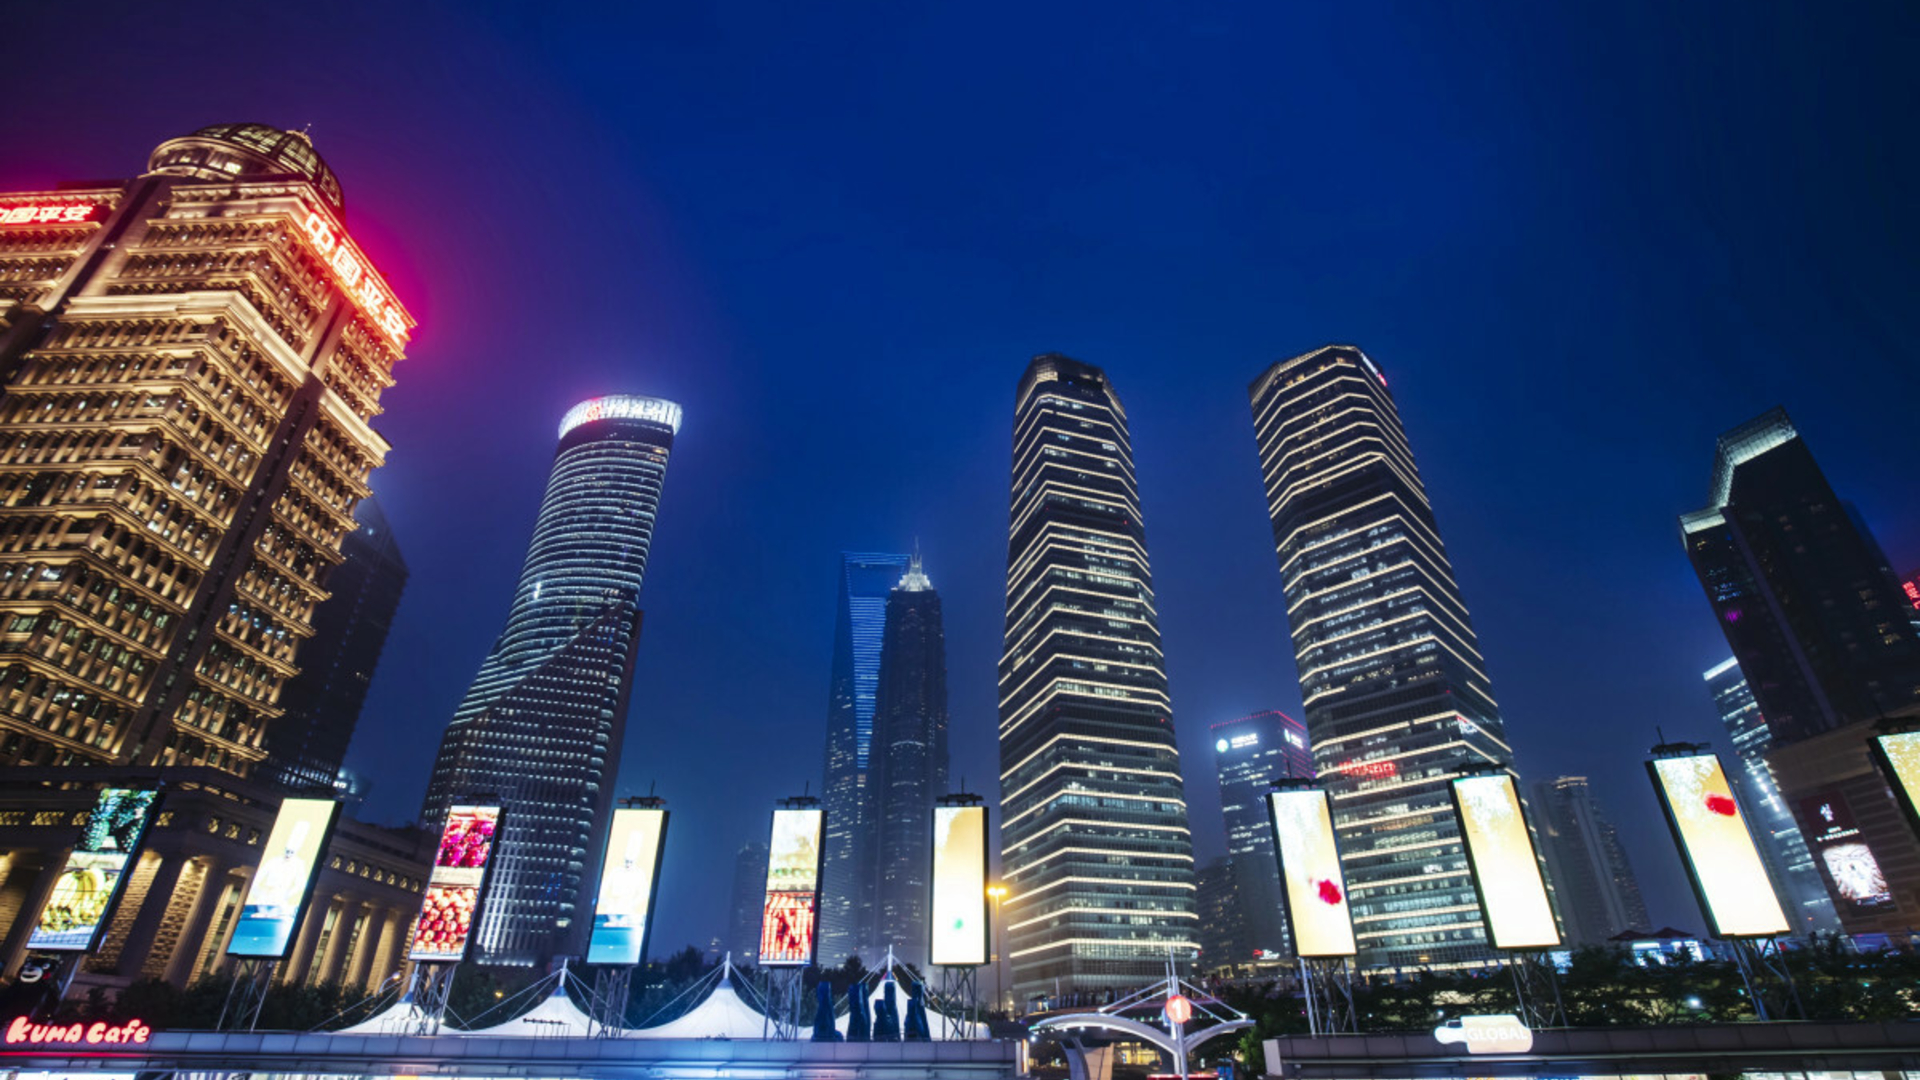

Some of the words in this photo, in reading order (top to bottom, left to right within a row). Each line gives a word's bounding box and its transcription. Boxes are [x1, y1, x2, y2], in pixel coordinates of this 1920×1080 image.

[305, 212, 409, 348] 中国平安
[1171, 999, 1182, 1020] 1
[85, 1018, 150, 1044] Cafe
[1466, 1026, 1528, 1042] GLOBAL
